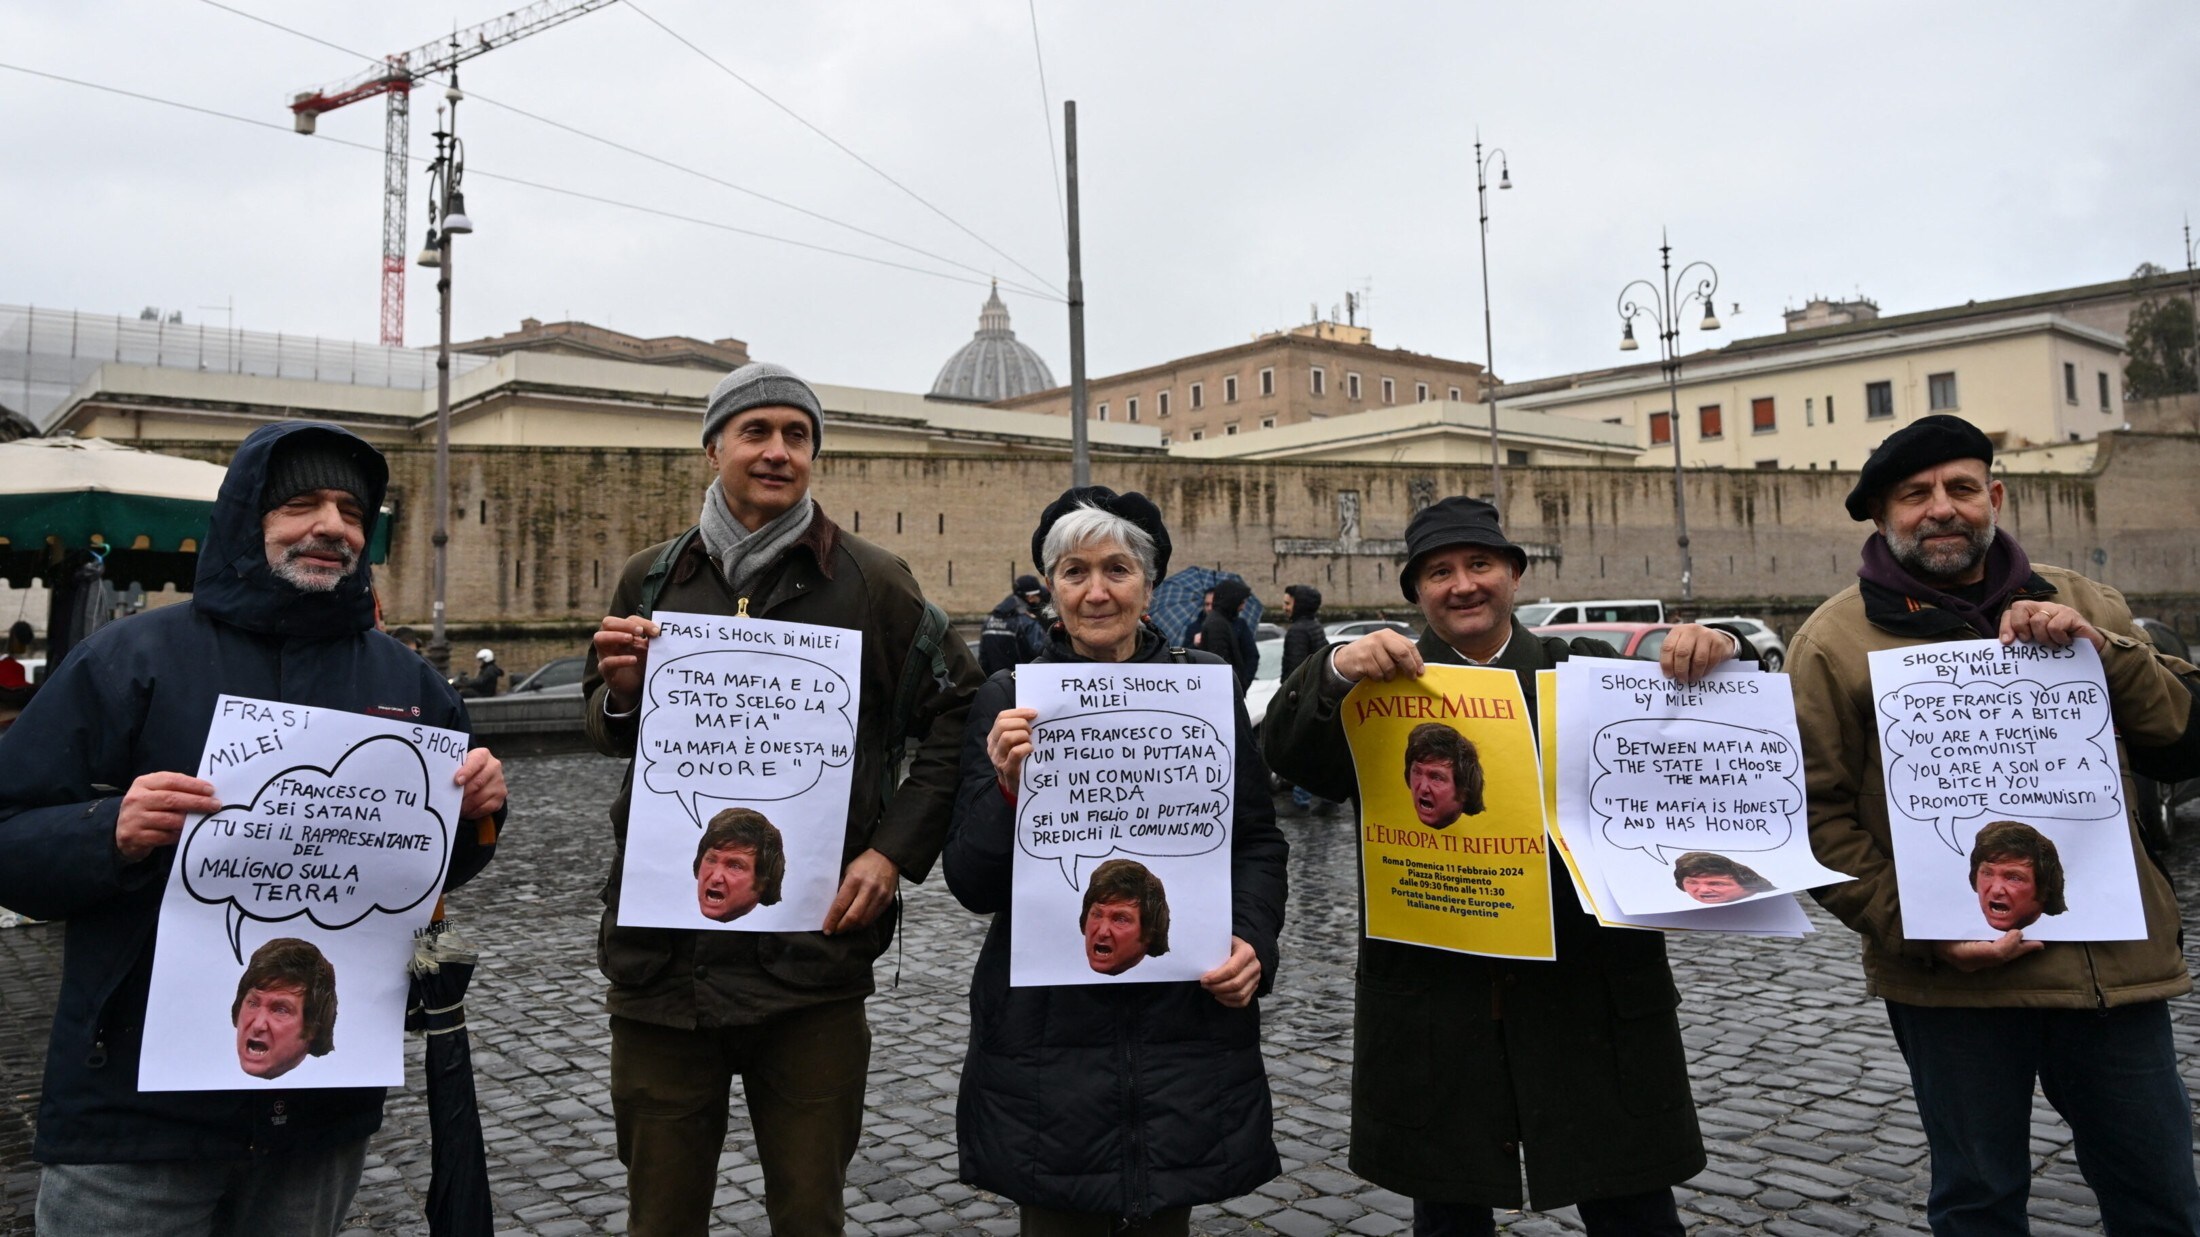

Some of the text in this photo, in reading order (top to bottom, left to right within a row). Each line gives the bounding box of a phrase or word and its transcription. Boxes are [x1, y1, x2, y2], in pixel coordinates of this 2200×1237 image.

[720, 627, 776, 645] SHOCK
[1903, 645, 2075, 667] SHOCKING PHRASES
[724, 674, 781, 691] MAFIA
[791, 679, 801, 691] E
[814, 681, 835, 693] LO
[1937, 665, 1958, 683] BY
[1123, 678, 1179, 693] SHOCK
[668, 690, 825, 713] STATO SCELGO LA
[1636, 694, 1652, 711] by
[2030, 690, 2060, 707] YOU
[2068, 688, 2097, 705] ARE
[1354, 692, 1517, 726] JAVIER MILEI
[1913, 711, 1927, 723] A
[1936, 709, 1971, 721] SON
[1980, 708, 2001, 720] OF
[2011, 708, 2023, 720] A
[1038, 728, 1074, 743] PAPA
[1082, 726, 1172, 741] FRANCESCO
[1902, 729, 1934, 746] YOU
[1942, 730, 1970, 743] ARE
[1979, 729, 1989, 741] A
[412, 727, 466, 766] SHOCK
[687, 741, 737, 755] MAFIA
[745, 736, 755, 754] È
[760, 741, 825, 755] ONESTA
[832, 744, 847, 758] HA
[1035, 748, 1054, 764] UN
[1144, 745, 1216, 760] PUTTANA
[1703, 740, 1754, 754] MAFIA
[1760, 740, 1788, 754] AND
[1069, 771, 1090, 785] UN
[1096, 765, 1198, 784] COMUNISTA
[1614, 758, 1782, 774] THE STATE I CHOOSE
[1908, 757, 2090, 781] YOU ARE A SON OF A
[1664, 774, 1692, 785] THE
[2005, 775, 2039, 792] YOU
[395, 790, 417, 807] TU
[1070, 785, 1144, 804] MERDA
[1910, 794, 1989, 811] PROMOTE
[304, 804, 381, 822] SATANA
[1061, 810, 1078, 823] UN
[1158, 801, 1220, 818] PUTTANA
[1656, 798, 1706, 814] MAFIA
[1734, 798, 1789, 814] HONEST
[210, 819, 235, 836] TU
[301, 826, 432, 851] RAPPRESENTANTE
[1130, 823, 1213, 838] COMUNISMO
[1624, 816, 1770, 835] AND HAS HONOR
[293, 843, 324, 857] DEL
[1440, 834, 1458, 852] TI
[1464, 834, 1545, 854] RIFIUTA!
[300, 863, 359, 882] SULLA
[1382, 856, 1524, 876] Roma Domenica 11 Febbraio 2024
[1400, 877, 1505, 896] dalle 09:30 fino alle 11:30
[1408, 868, 1492, 886] Piazza Risorgimento
[1392, 886, 1515, 910] Portate bandiere Europee,
[1407, 899, 1499, 918] Italiane e Argentine
